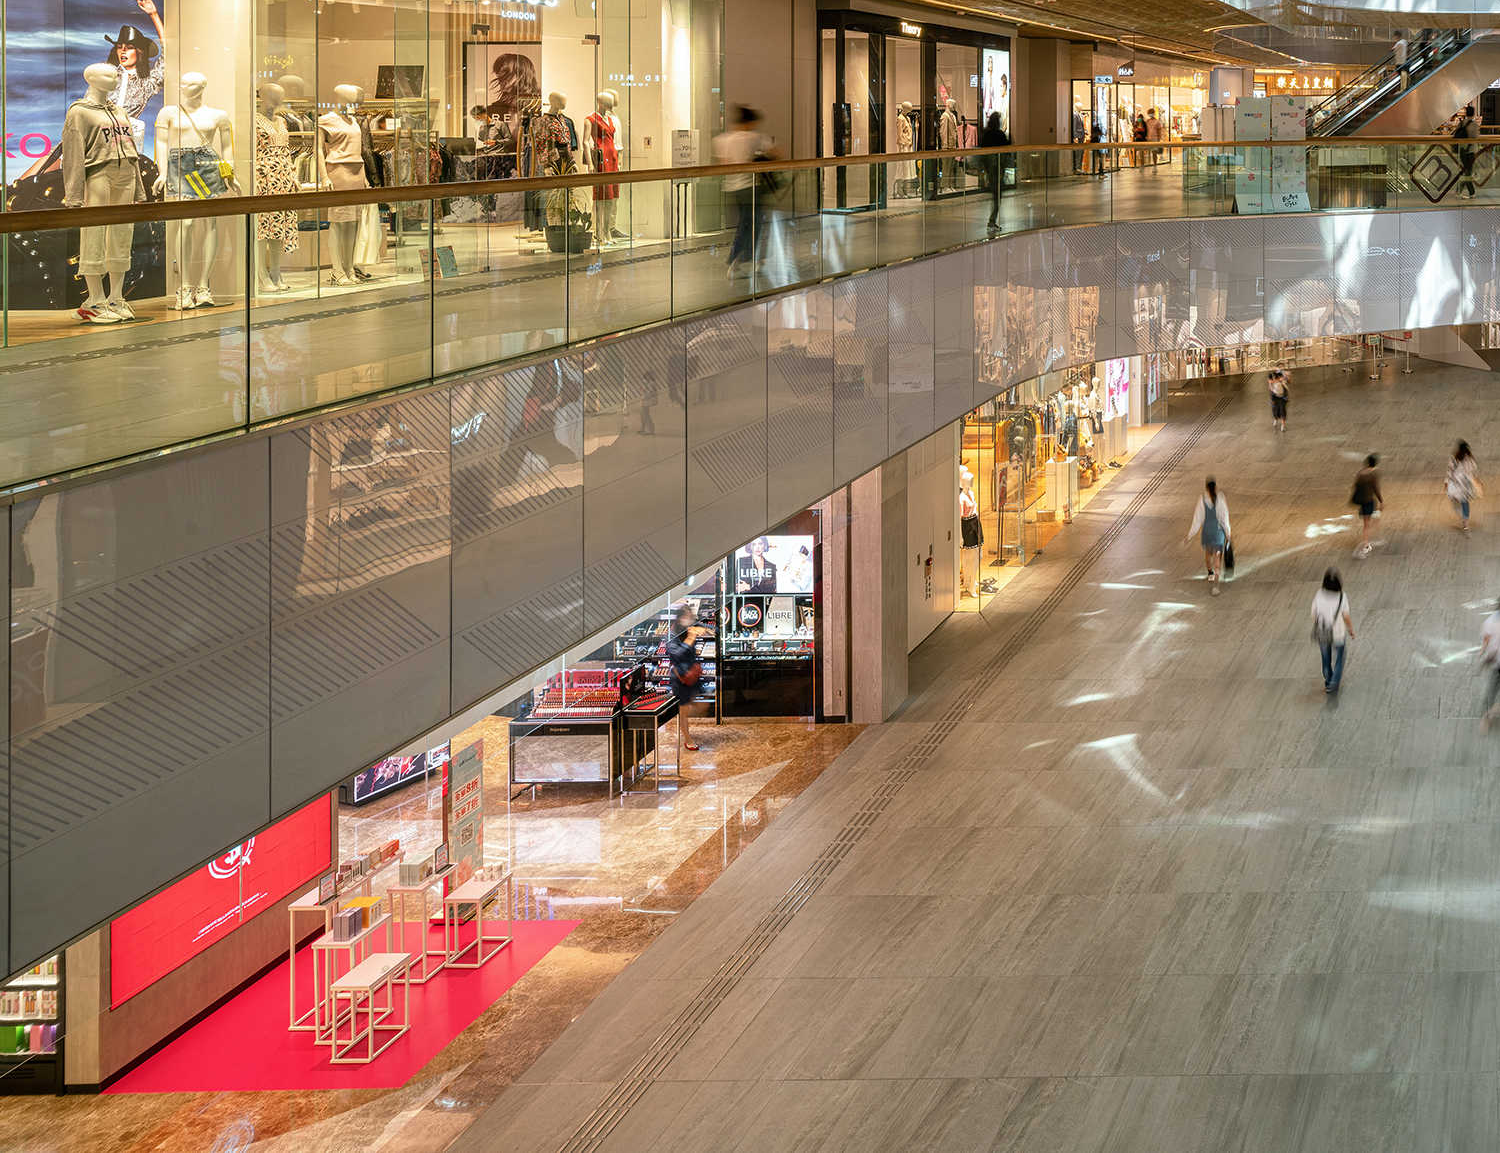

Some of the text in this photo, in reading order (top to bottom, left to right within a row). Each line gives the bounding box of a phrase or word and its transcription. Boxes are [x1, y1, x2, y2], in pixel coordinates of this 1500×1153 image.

[501, 9, 536, 20] LONDON
[901, 22, 921, 37] Theory
[740, 568, 773, 578] LIBRE
[767, 611, 793, 619] LIBRE
